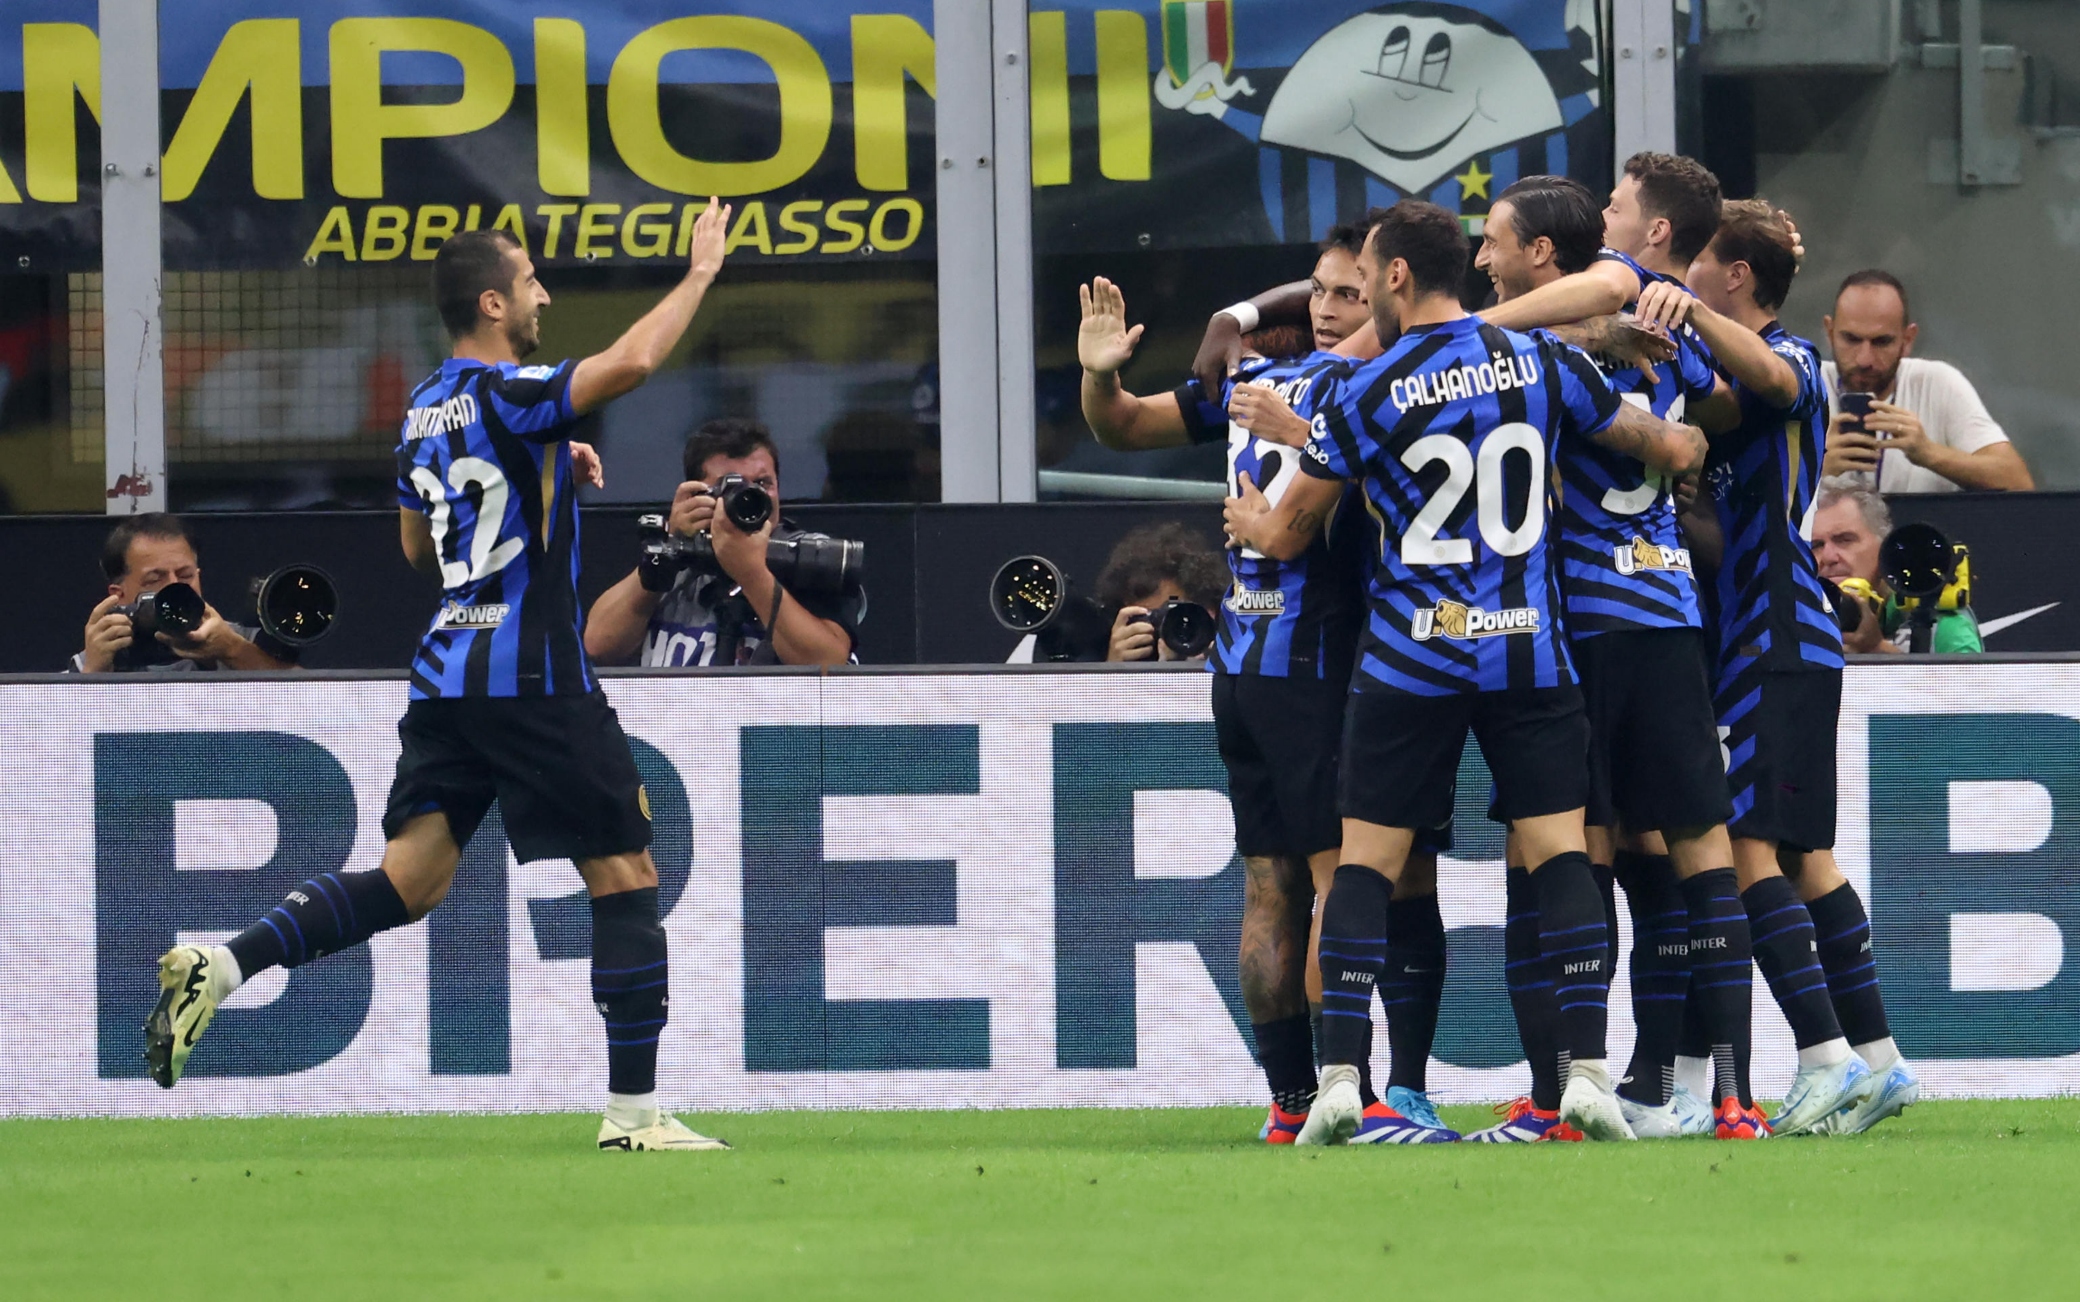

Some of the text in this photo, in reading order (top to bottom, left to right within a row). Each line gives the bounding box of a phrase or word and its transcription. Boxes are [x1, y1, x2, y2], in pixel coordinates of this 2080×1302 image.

[0, 10, 1152, 204] MPIONI
[1390, 351, 1539, 414] ÇALHANOĞLU
[1400, 422, 1546, 565] 20
[410, 457, 525, 589] 22
[1465, 608, 1538, 637] Power
[1691, 936, 1728, 950] INTER
[1340, 970, 1375, 984] INTER
[1564, 959, 1601, 975] INTER
